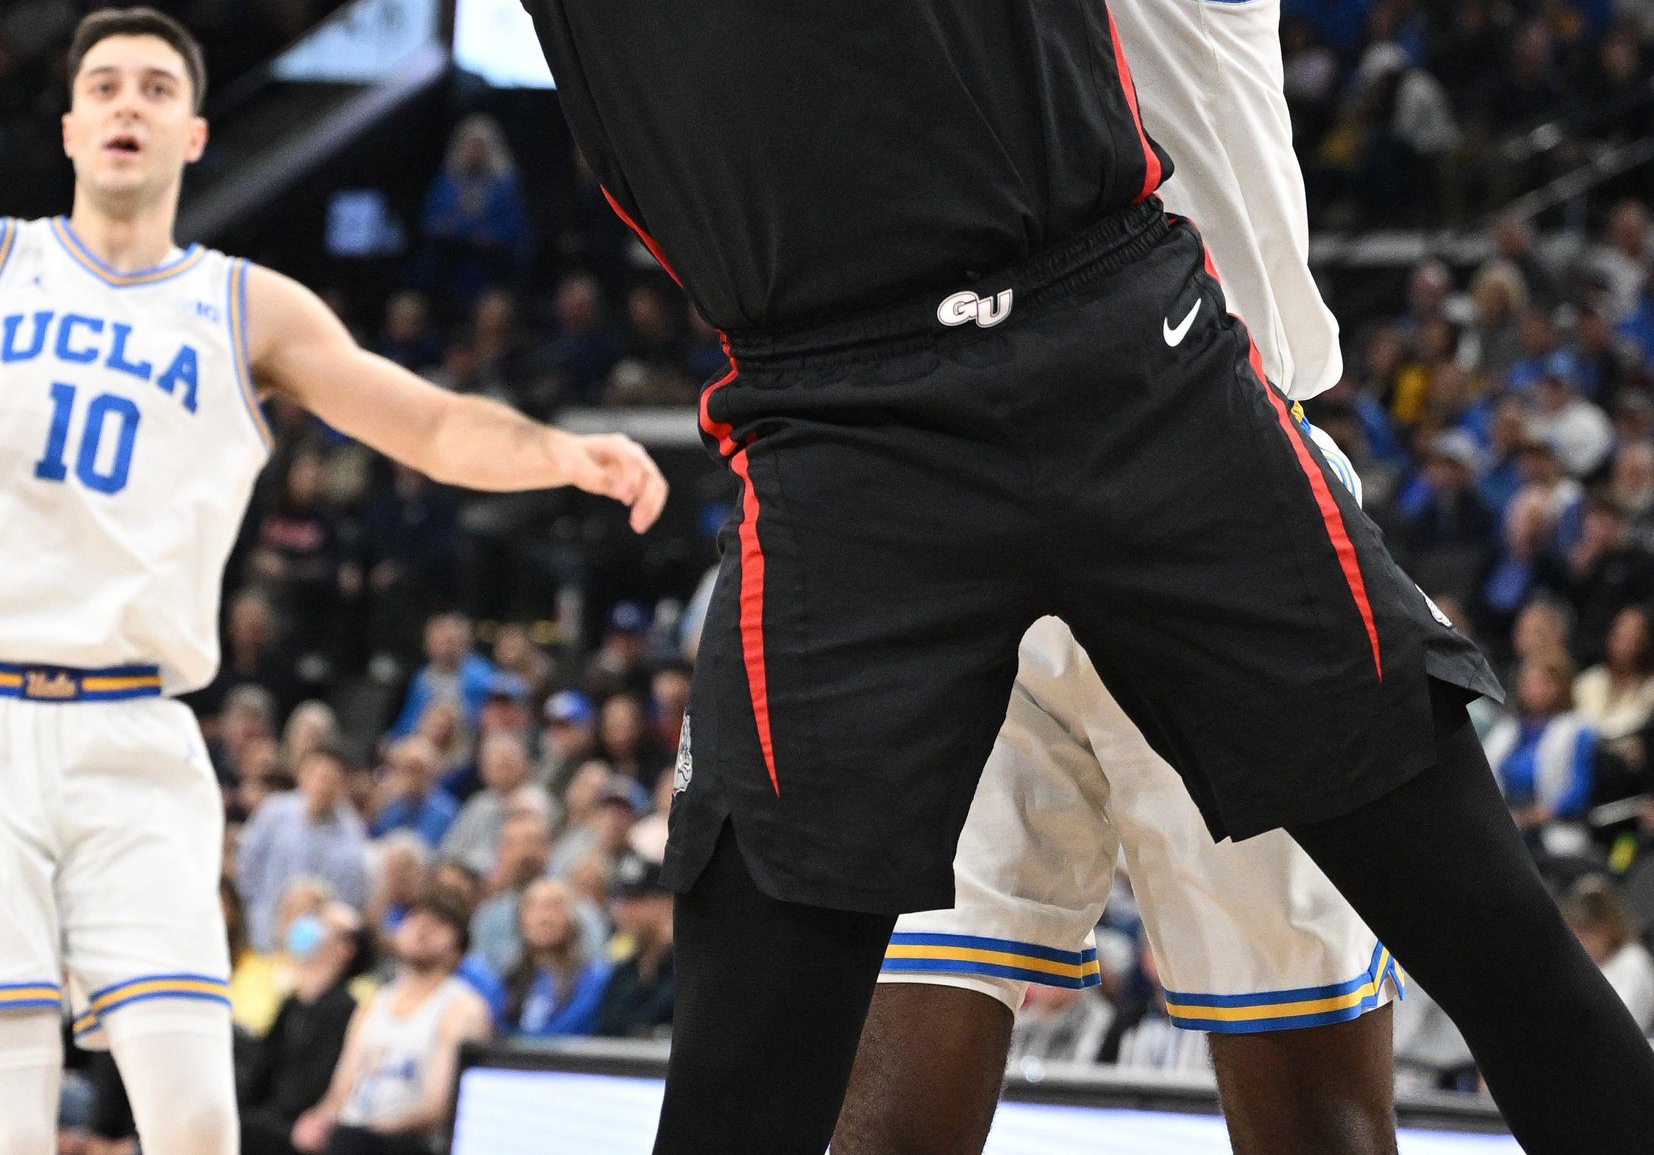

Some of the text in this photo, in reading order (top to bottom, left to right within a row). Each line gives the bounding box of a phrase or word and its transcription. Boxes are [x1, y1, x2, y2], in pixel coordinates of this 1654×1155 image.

[937, 289, 1013, 329] GU
[0, 311, 198, 415] UCLA
[34, 382, 141, 496] 10
